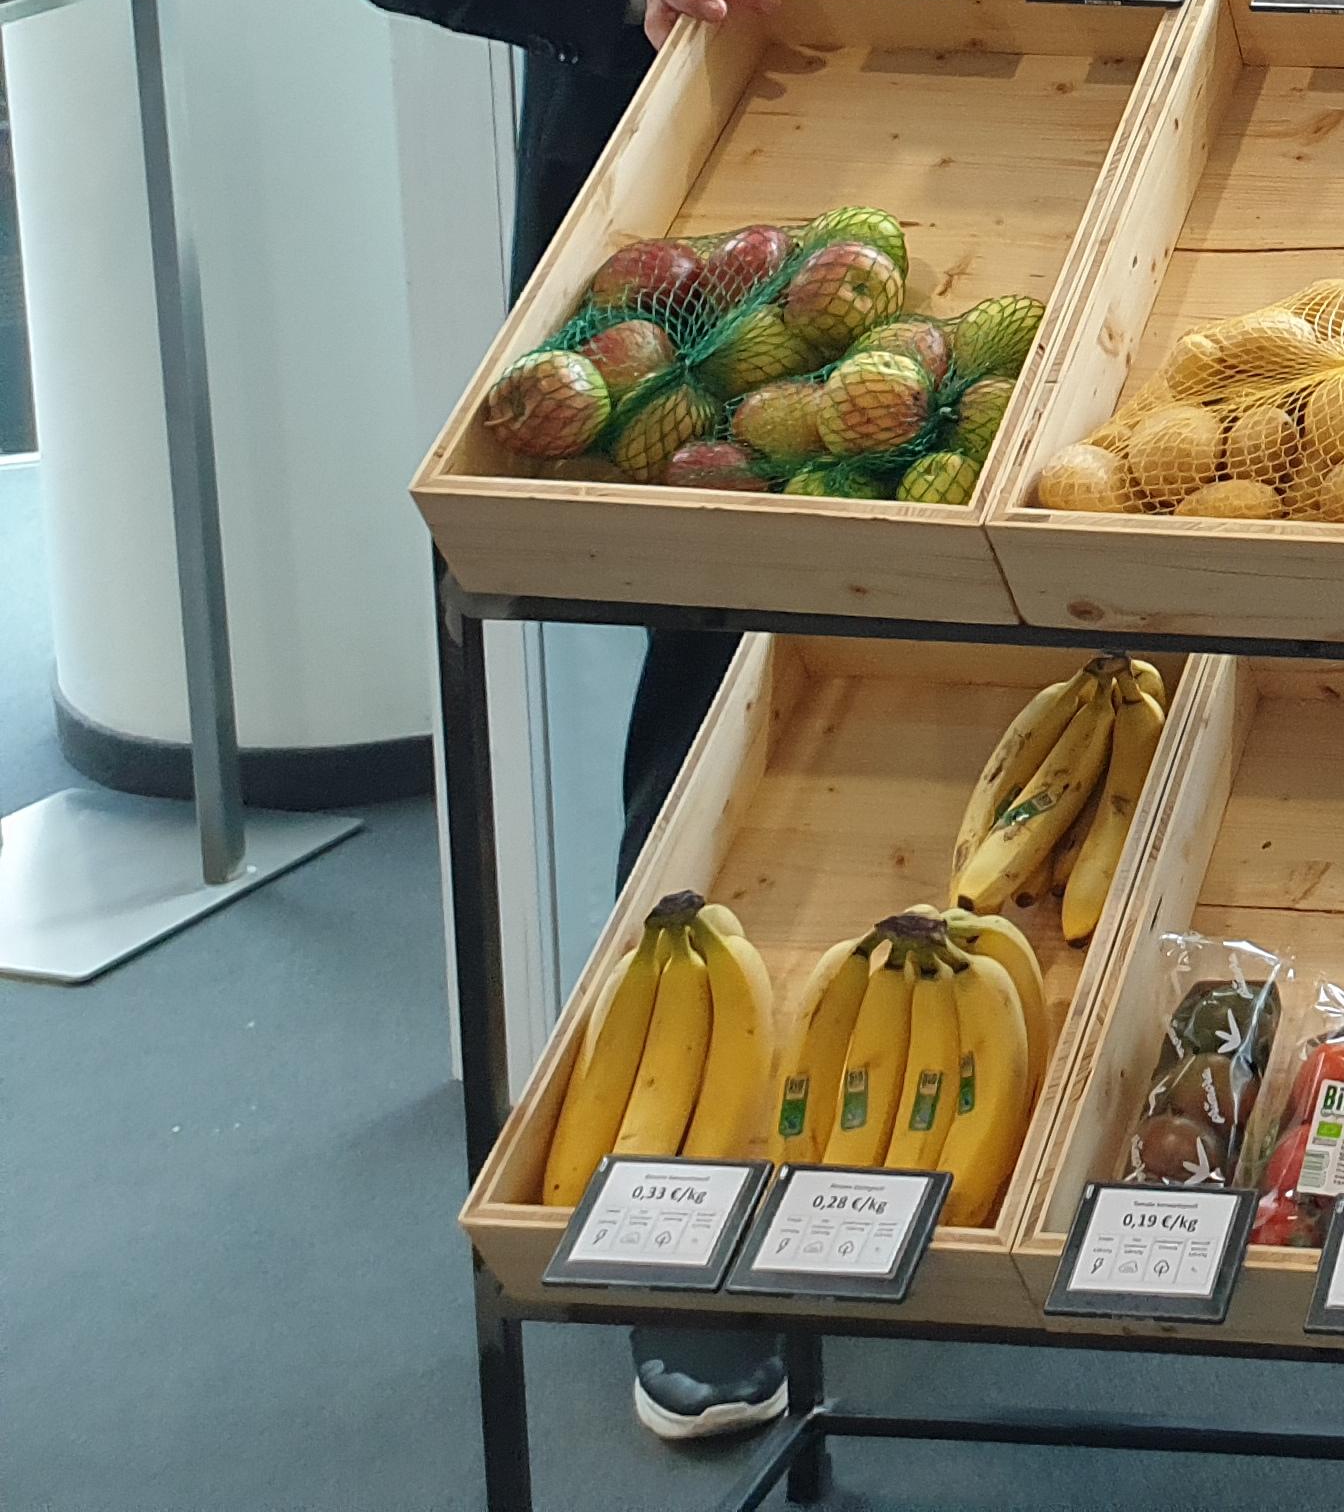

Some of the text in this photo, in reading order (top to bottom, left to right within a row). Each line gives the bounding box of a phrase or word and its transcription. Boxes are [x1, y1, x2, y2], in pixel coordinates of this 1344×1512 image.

[631, 1185, 708, 1205] 0,33 €/kg
[812, 1194, 889, 1215] 0,28 €/kg
[1122, 1213, 1199, 1232] 0,19 €/kg
